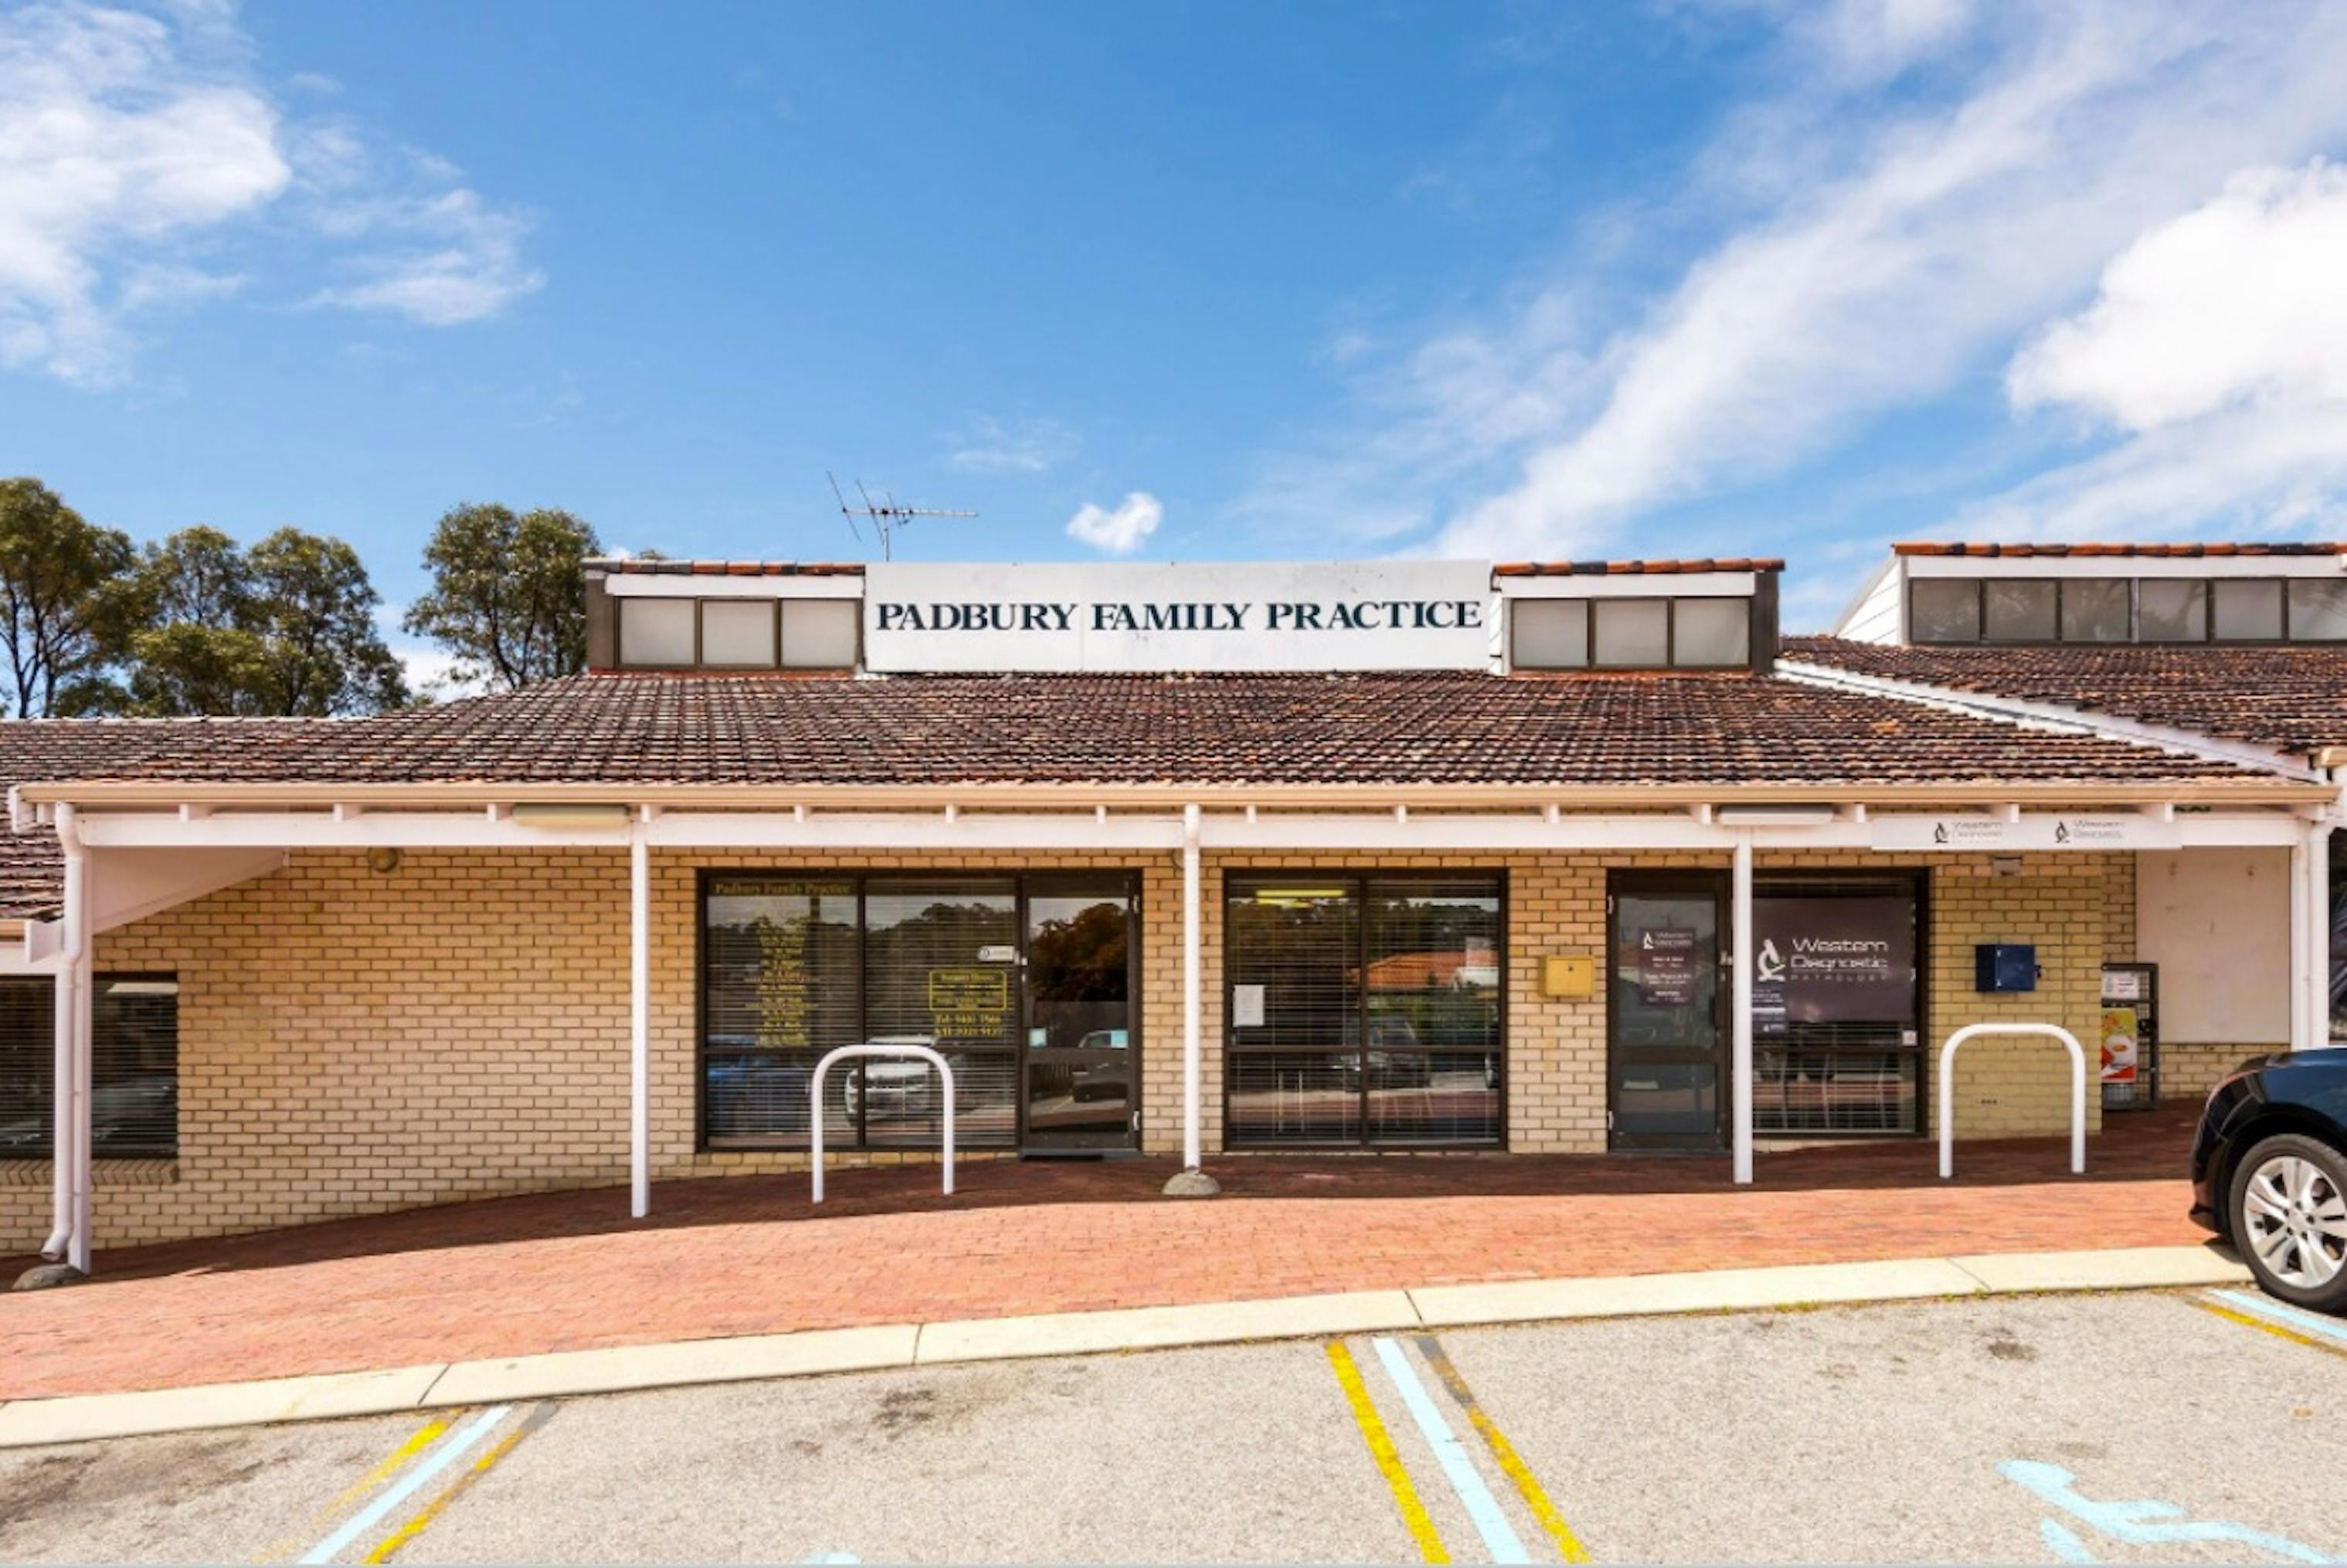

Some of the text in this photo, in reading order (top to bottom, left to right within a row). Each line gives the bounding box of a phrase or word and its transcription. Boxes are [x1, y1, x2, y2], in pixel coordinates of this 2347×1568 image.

[876, 600, 1483, 631] PADBURY FAMILY PRACTICE
[1792, 938, 1889, 952] Western
[1790, 954, 1888, 972] Diagnostic
